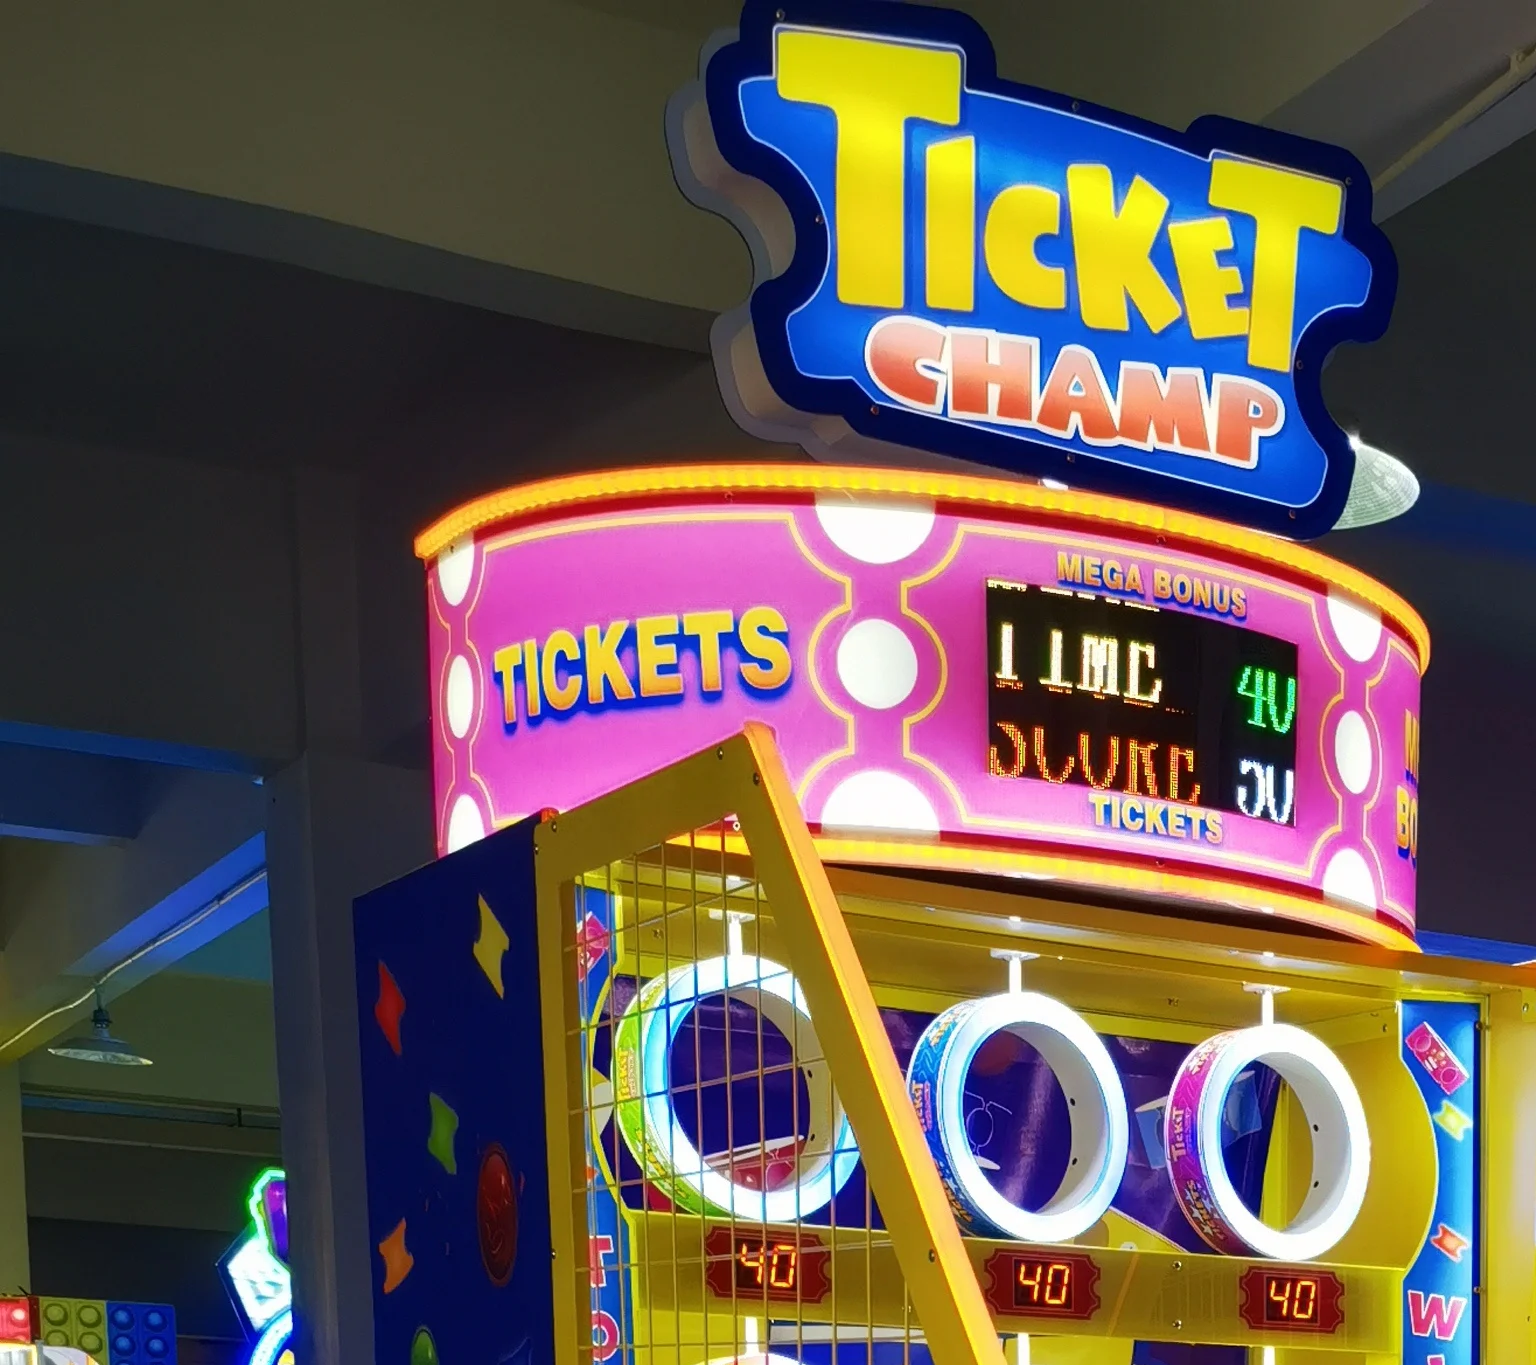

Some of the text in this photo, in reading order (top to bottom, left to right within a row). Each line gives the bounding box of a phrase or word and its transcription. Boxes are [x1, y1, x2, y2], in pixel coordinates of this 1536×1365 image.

[775, 30, 1343, 372] TICKET
[864, 316, 1285, 469] CHAMP
[1057, 551, 1247, 619] MEGA BONUS
[491, 607, 794, 732] TICKETS
[1089, 793, 1223, 845] TICKETS
[740, 1242, 798, 1288] 40
[1018, 1261, 1071, 1306] 40
[1268, 1279, 1317, 1320] 40
